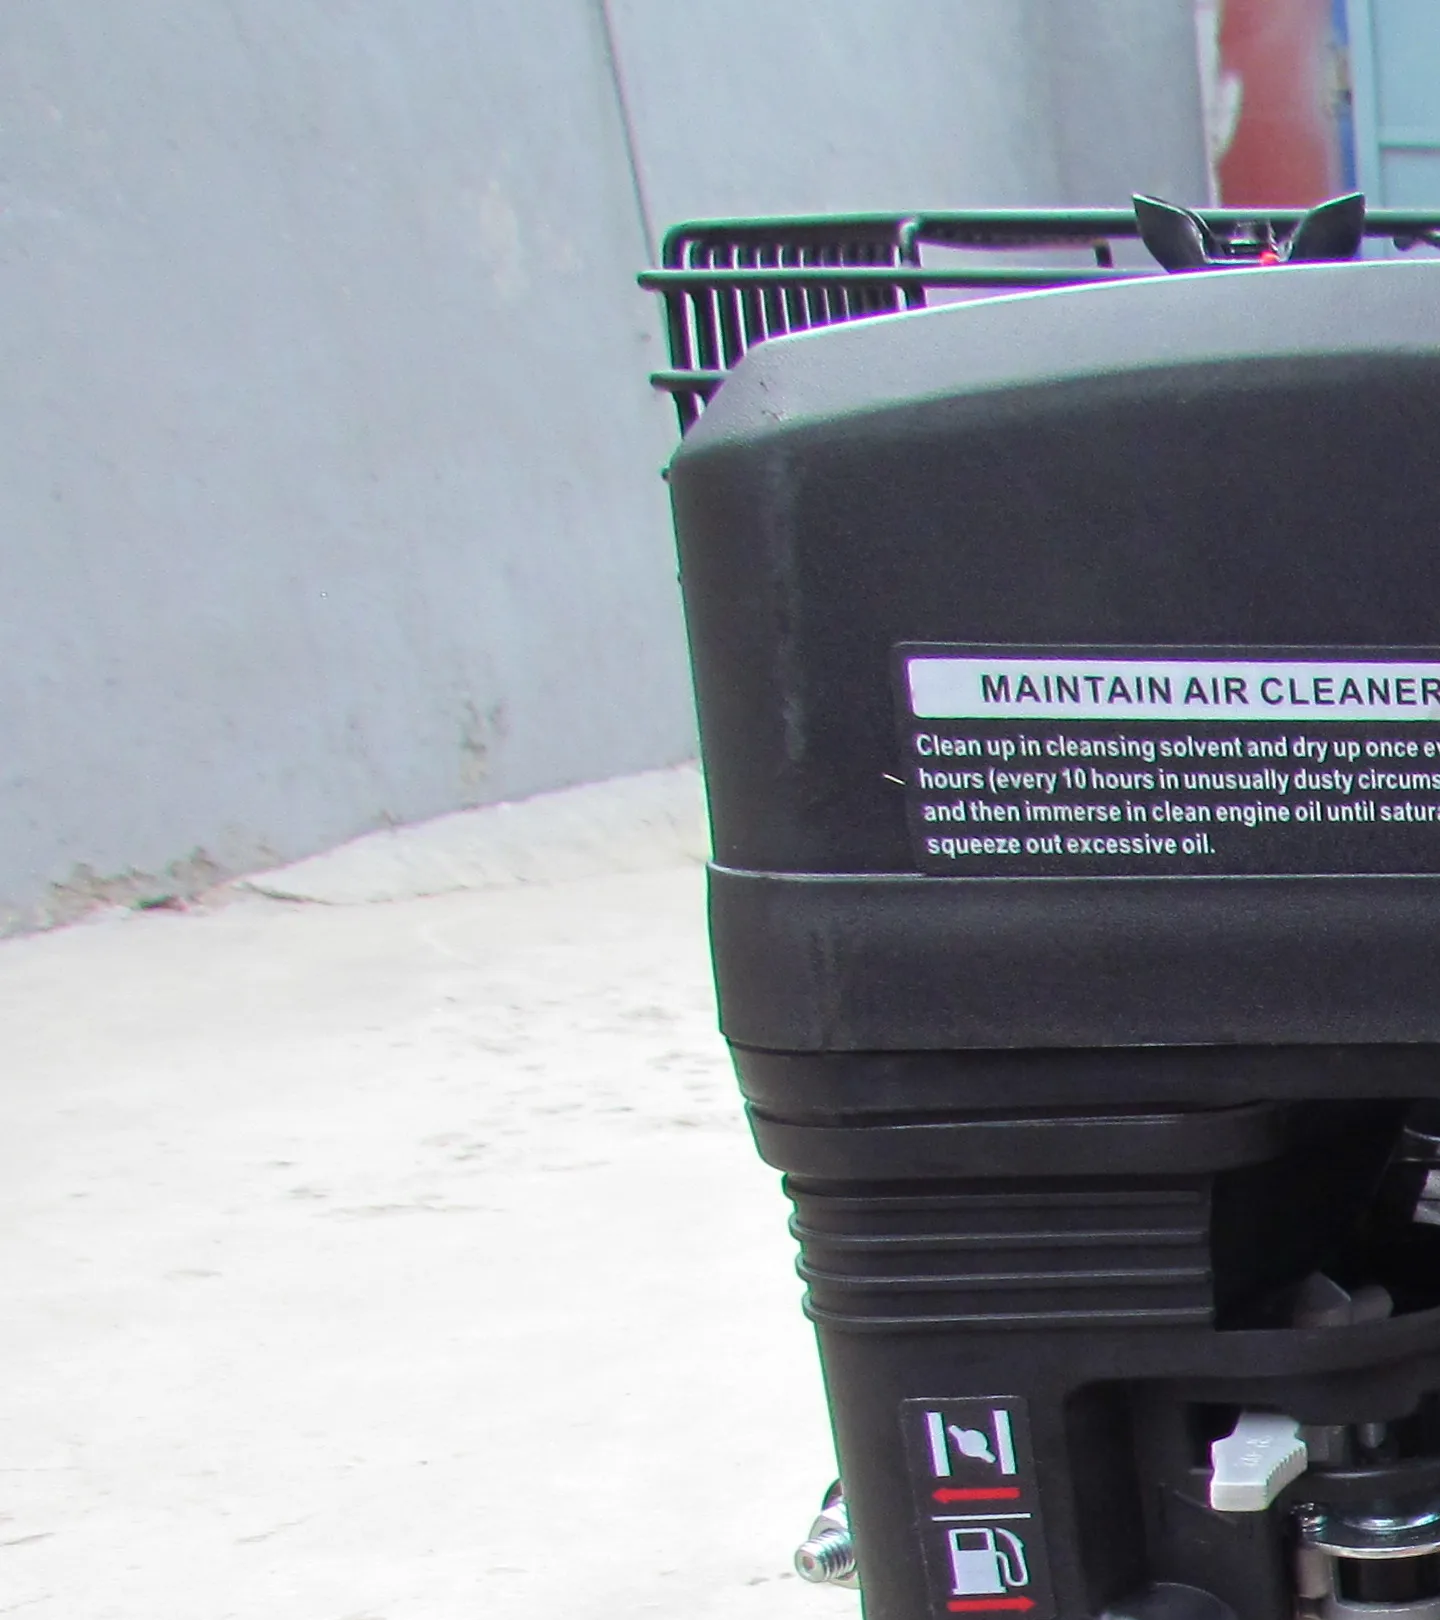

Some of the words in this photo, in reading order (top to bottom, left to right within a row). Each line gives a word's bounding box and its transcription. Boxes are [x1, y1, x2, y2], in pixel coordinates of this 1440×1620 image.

[981, 674, 1172, 704] MAINTAIN
[1184, 677, 1248, 705] AIR
[916, 734, 982, 757] Clean
[987, 740, 1016, 761] up
[1020, 735, 1042, 756] in
[1047, 735, 1156, 762] cleansing
[1160, 735, 1242, 758] solvent
[1248, 737, 1287, 758] and
[1293, 736, 1328, 763] dry
[1333, 740, 1361, 762] up
[1366, 741, 1419, 758] once
[919, 768, 984, 789] hours
[989, 767, 1057, 793] (every
[1062, 768, 1087, 789] 10
[1092, 768, 1155, 790] hours
[1160, 768, 1179, 790] in
[1184, 768, 1289, 795] unusually
[1294, 768, 1353, 794] dusty
[923, 800, 966, 822] and
[970, 800, 1021, 822] then
[1025, 800, 1122, 822] immerse
[1126, 801, 1147, 822] in
[1152, 800, 1211, 822] clean
[1216, 802, 1290, 827] engine
[1295, 801, 1322, 822] oil
[1327, 801, 1375, 822] until
[928, 837, 1021, 859] squeeze
[1026, 835, 1062, 855] out
[1066, 834, 1177, 855] excessive
[1182, 834, 1216, 856] oil.
